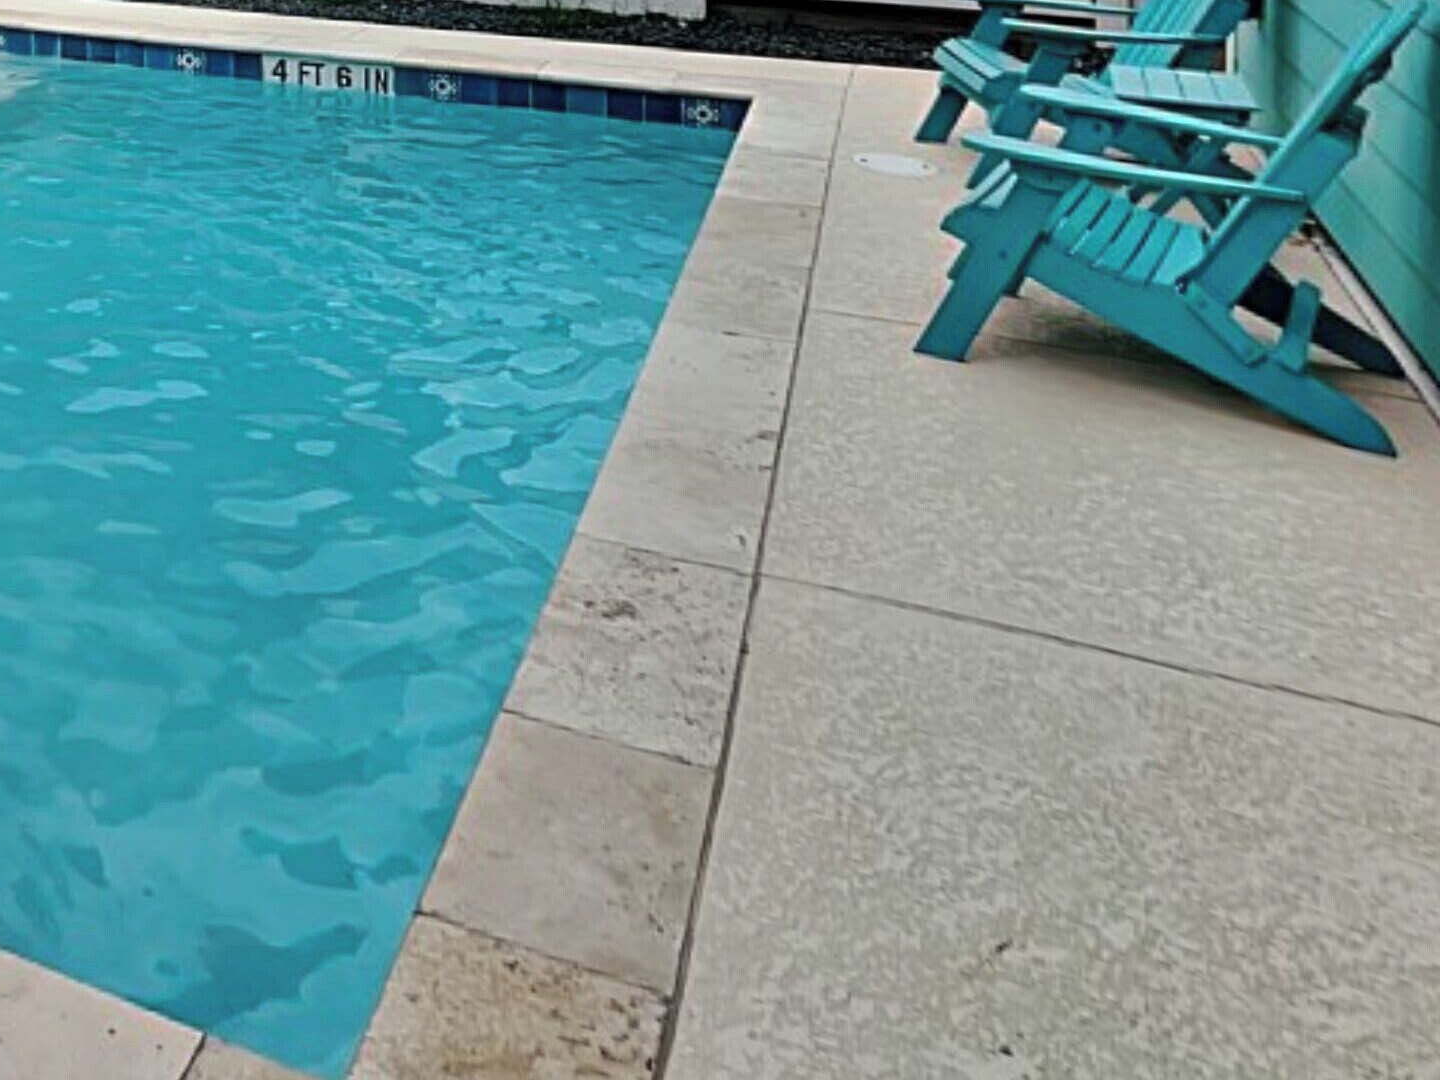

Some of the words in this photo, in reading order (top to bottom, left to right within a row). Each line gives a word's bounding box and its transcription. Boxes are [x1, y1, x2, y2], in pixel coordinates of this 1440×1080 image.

[271, 58, 288, 83] 4
[298, 62, 325, 86] FT
[336, 66, 352, 89] 6
[363, 67, 389, 95] IN
